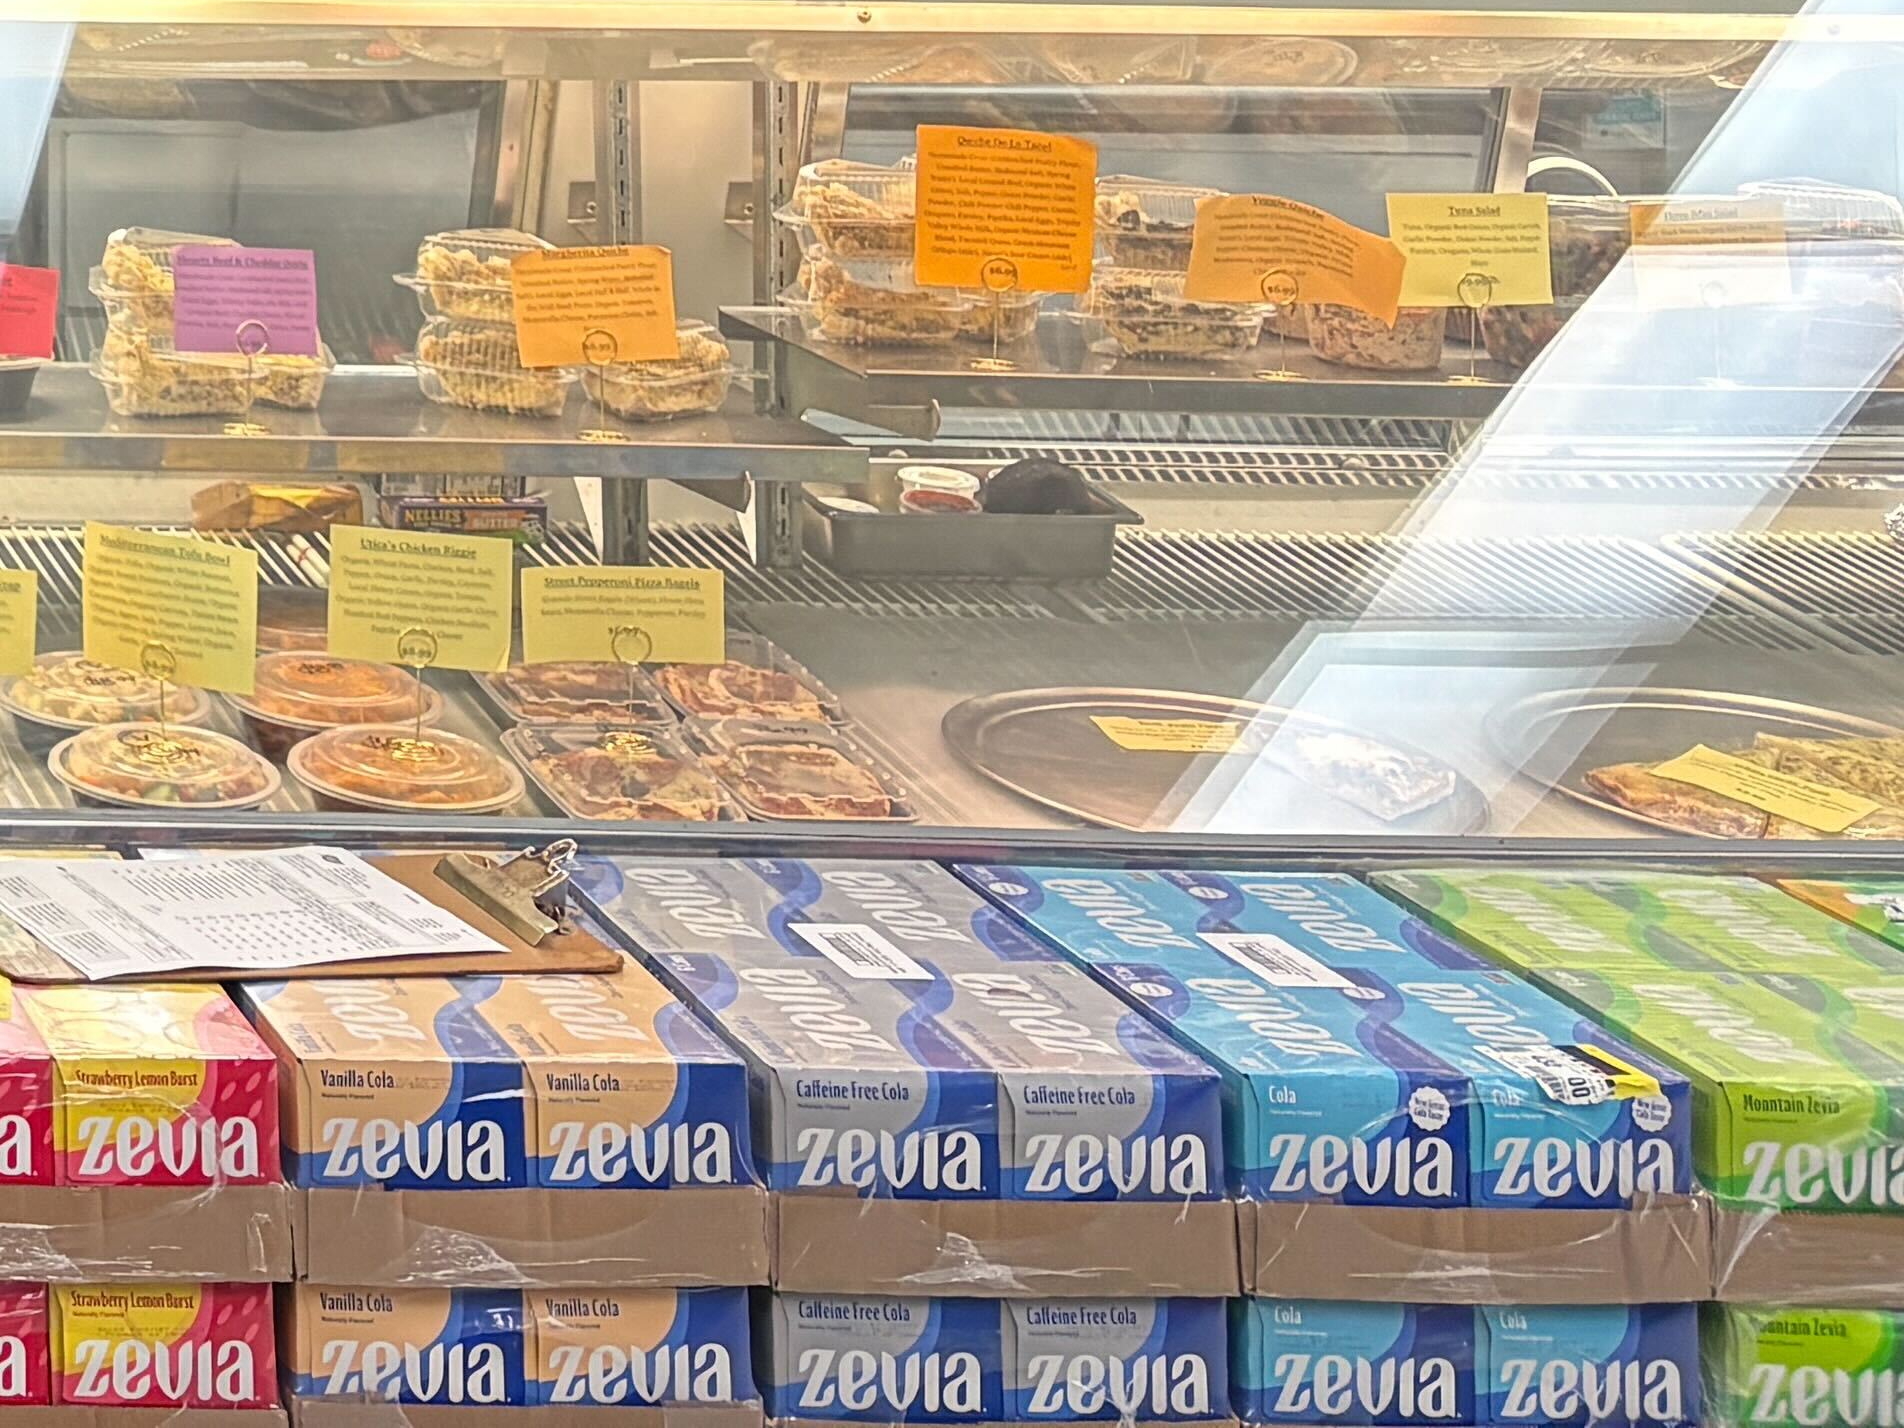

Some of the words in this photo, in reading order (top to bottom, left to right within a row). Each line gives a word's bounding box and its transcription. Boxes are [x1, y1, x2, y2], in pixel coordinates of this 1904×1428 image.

[321, 1069, 364, 1087] Vanilla
[367, 1070, 394, 1088] Cola
[796, 1079, 848, 1100] Caffeine
[851, 1082, 879, 1100] Free
[882, 1083, 909, 1101] Cola
[76, 1113, 260, 1179] zevia
[321, 1115, 508, 1184] zevia
[547, 1119, 733, 1185] zevia
[796, 1127, 982, 1192] zevia
[1024, 1133, 1208, 1195] zevia
[1267, 1132, 1454, 1197] zevia
[1492, 1135, 1675, 1198] zevia
